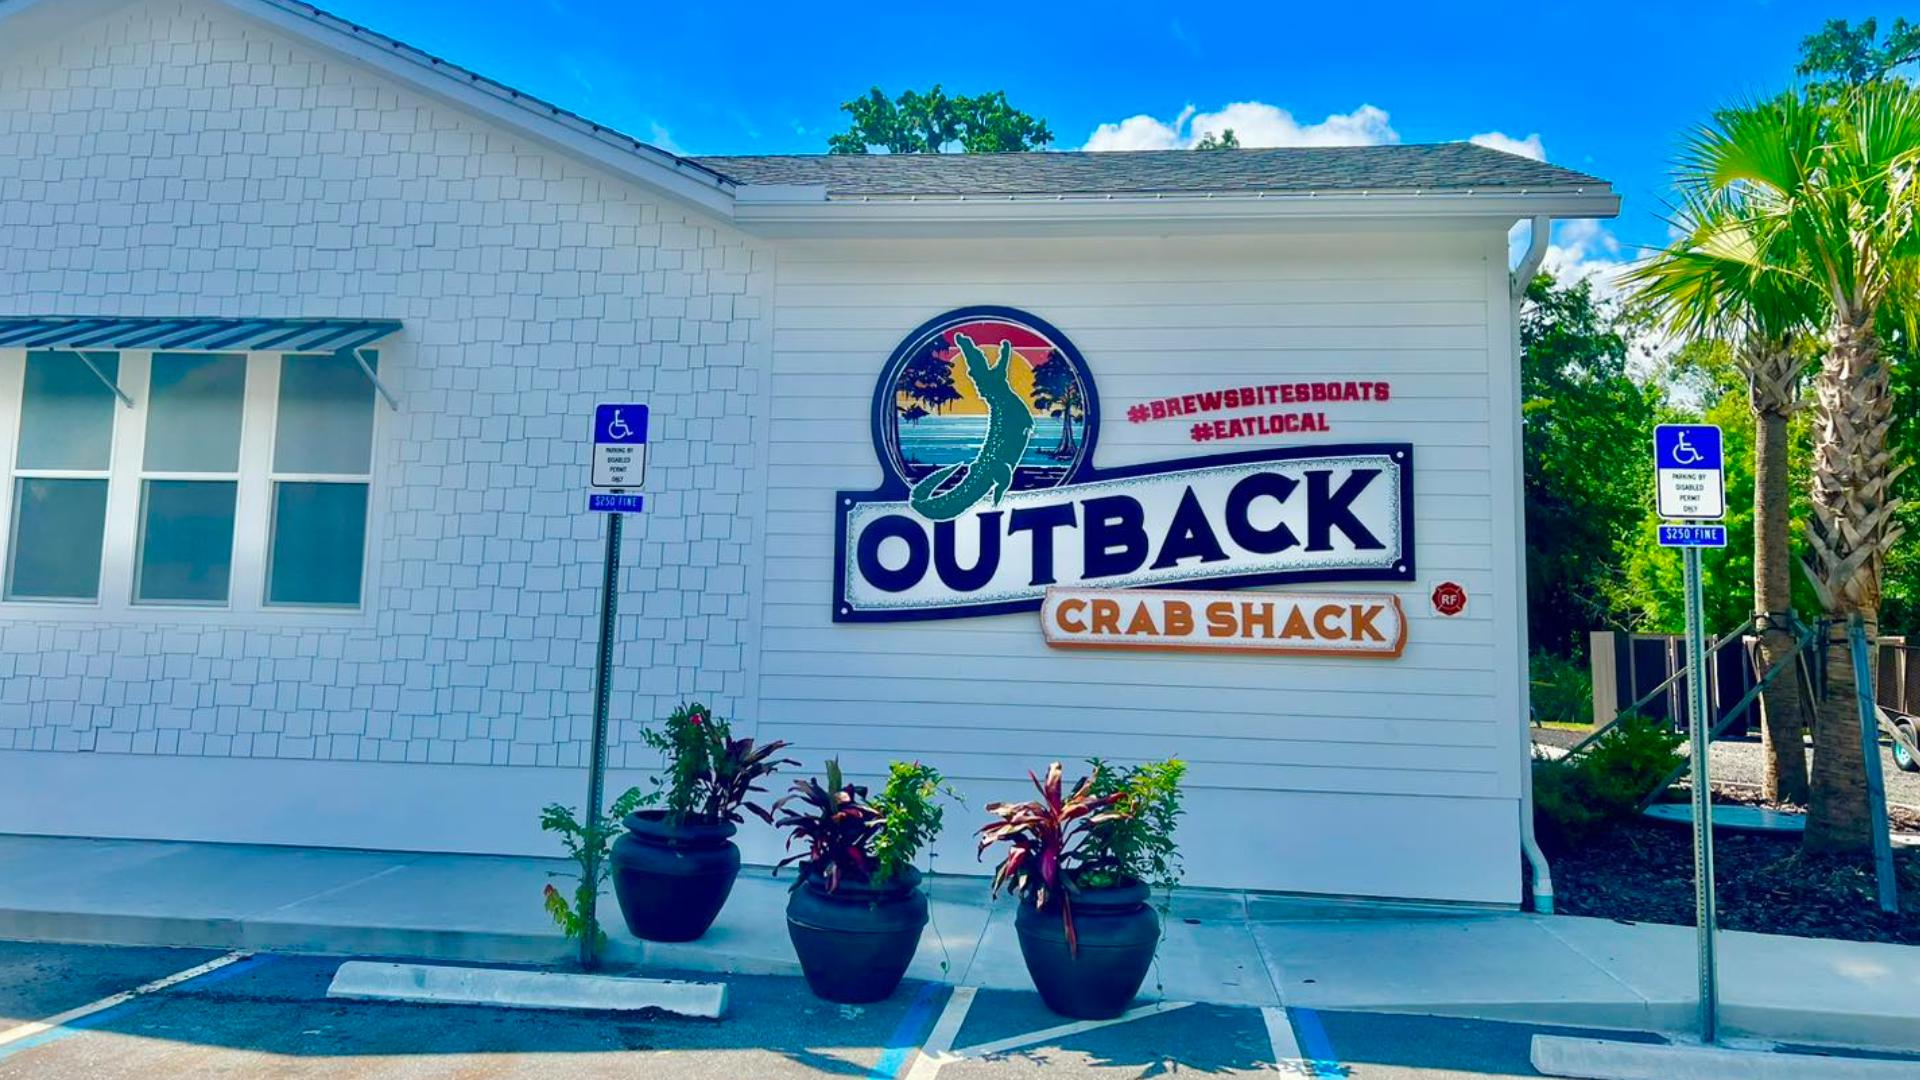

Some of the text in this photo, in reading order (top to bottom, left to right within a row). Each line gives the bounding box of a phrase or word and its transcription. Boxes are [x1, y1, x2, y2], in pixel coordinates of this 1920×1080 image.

[1127, 381, 1390, 424] #BREWSBITESBOATS
[1190, 412, 1330, 442] #EATLOCAL
[595, 495, 616, 507] $250
[857, 469, 1387, 592] OUTBACK
[1666, 528, 1717, 540] $250 FINE
[1441, 594, 1457, 605] RF
[1055, 598, 1388, 642] CRAB SHACK
